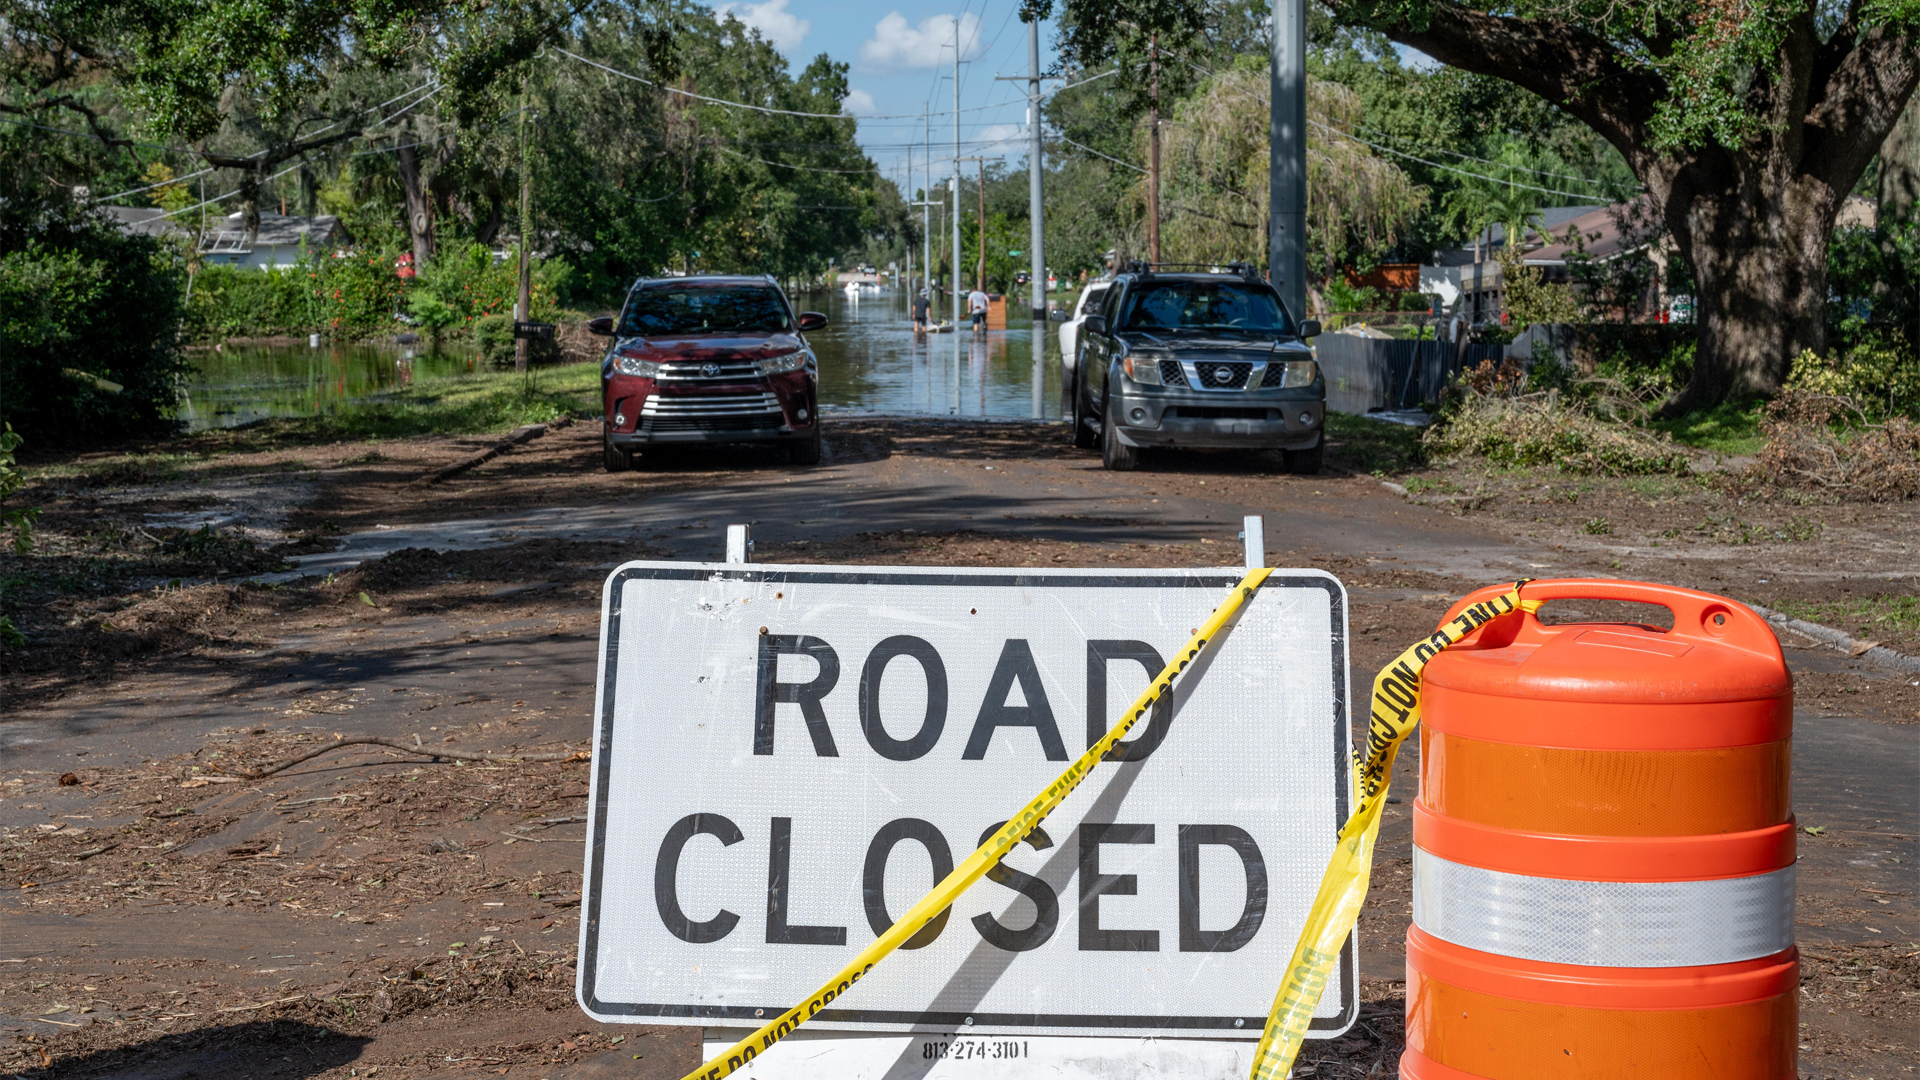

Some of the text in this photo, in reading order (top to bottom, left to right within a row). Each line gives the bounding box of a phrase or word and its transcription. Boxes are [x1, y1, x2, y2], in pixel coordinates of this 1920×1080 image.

[753, 634, 1174, 762] ROAD
[1375, 660, 1419, 724] NOT
[654, 812, 1268, 952] CLOSED
